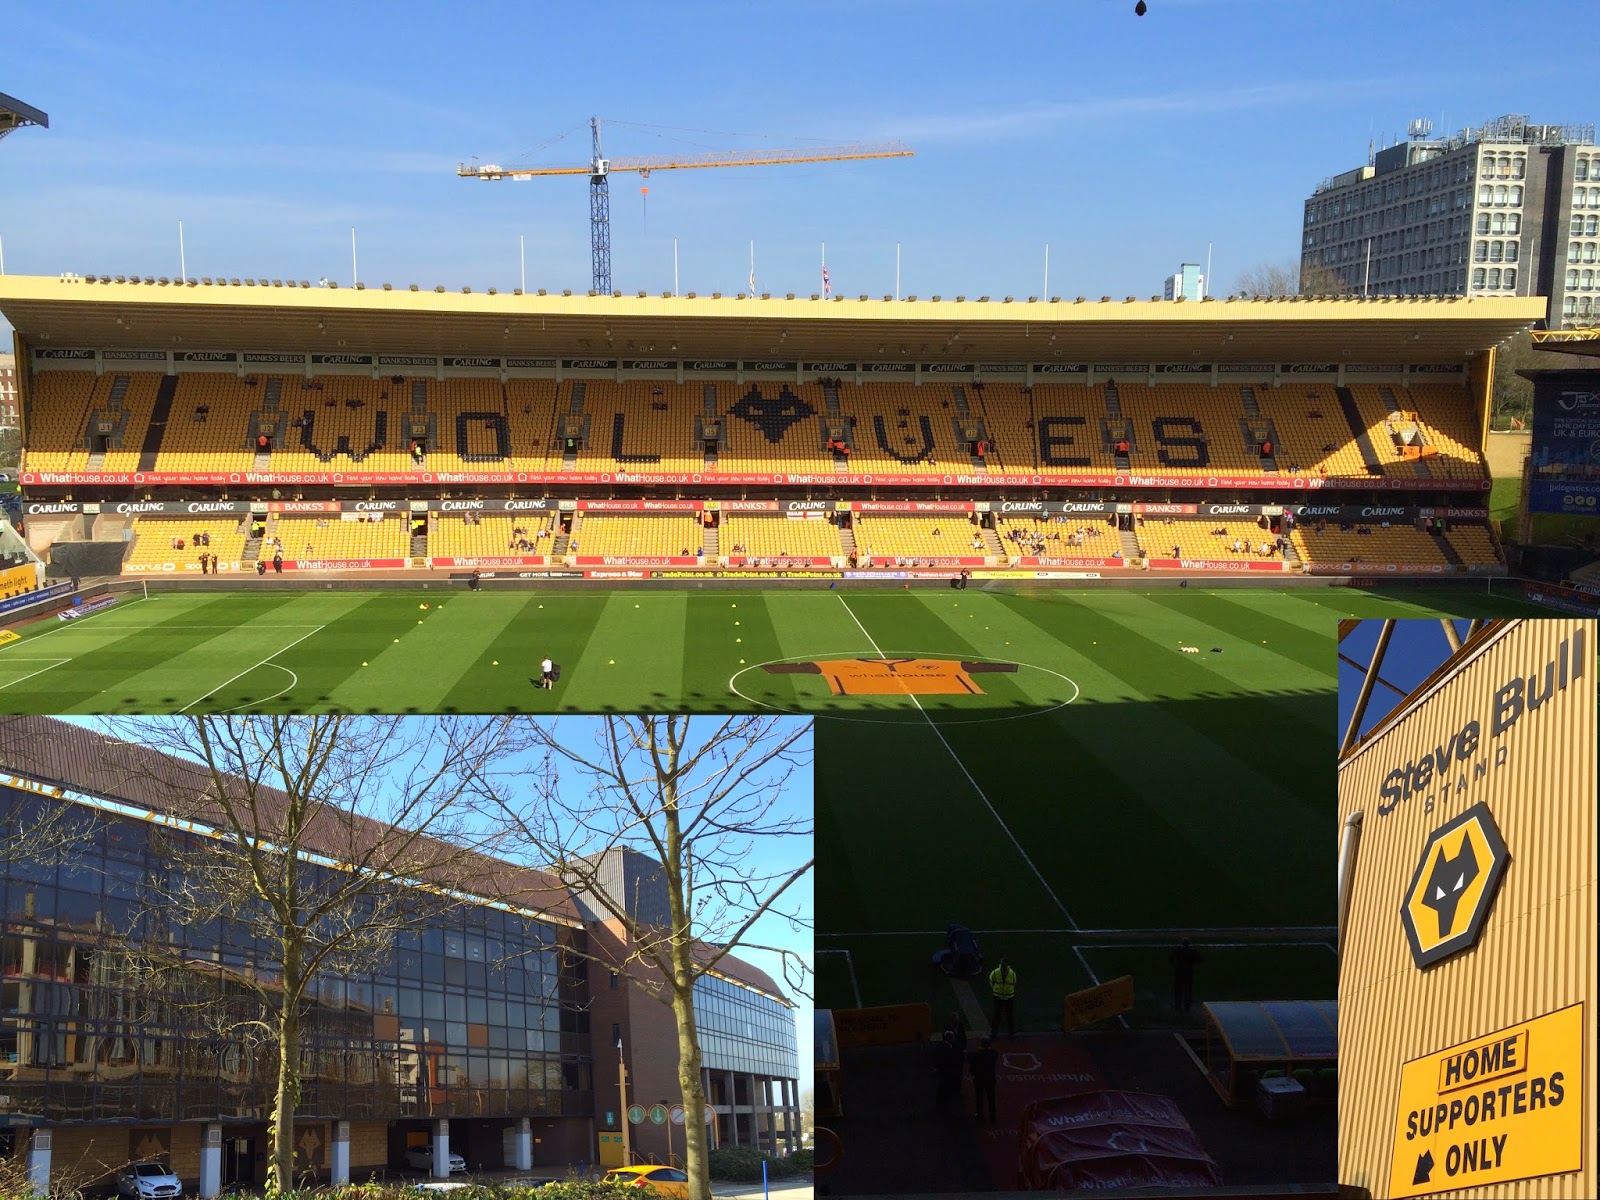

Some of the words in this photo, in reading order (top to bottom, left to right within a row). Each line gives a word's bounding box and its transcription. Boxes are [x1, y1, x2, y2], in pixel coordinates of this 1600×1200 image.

[183, 352, 228, 362] CARLING
[246, 354, 278, 362] BANKS'S
[279, 355, 304, 363] BEERS
[321, 354, 363, 364] CARLING
[413, 357, 435, 365] BEERS
[452, 358, 492, 368] CARLING
[570, 359, 609, 369] CARLING
[632, 360, 669, 370] CARLING
[693, 361, 727, 370] CARLING
[754, 362, 786, 371] CARLING
[811, 362, 848, 372] CARLING
[871, 363, 907, 373] CARLING
[929, 363, 966, 373] CARLING
[1289, 363, 1330, 373] CARLING
[1041, 364, 1080, 373] CARLING
[1163, 364, 1204, 374] CARLING
[1553, 429, 1567, 437] UK
[40, 473, 129, 483] WhatHouse.co.uk
[246, 473, 329, 482] WhatHouse.co.uk
[437, 473, 514, 482] WhatHouse.co.uk
[614, 473, 689, 482] WhatHouse.co.uk
[787, 474, 860, 483] WhatHouse.co.uk
[956, 475, 1029, 484] WhatHouse.co.uk
[1128, 476, 1204, 486] WhatHouse.co.uk
[1308, 478, 1388, 488] WhatHouse.co.uk
[28, 503, 77, 514] CARLING
[116, 502, 164, 513] CARLING
[187, 502, 234, 513] CARLING
[284, 502, 324, 511] BANKS'S
[355, 501, 396, 511] CARLING
[441, 500, 484, 511] CARLING
[504, 500, 546, 510] CARLING
[587, 501, 638, 509] WhatHouse.co.uk
[643, 501, 694, 509] WhatHouse.co.uk
[732, 501, 768, 510] BANKS'S
[788, 501, 826, 511] CARLING
[861, 502, 911, 510] WhatHouse.co.uk
[916, 502, 965, 510] WhatHouse.co.uk
[1001, 502, 1043, 512] CARLING
[1062, 502, 1105, 513] CARLING
[1145, 504, 1182, 513] BANKS'S
[1209, 505, 1250, 514] CARLING
[1297, 506, 1340, 516] CARLING
[1361, 507, 1405, 517] CARLING
[1447, 509, 1488, 518] BANKS'S
[296, 560, 371, 569] WhatHouse.co.uk
[453, 557, 523, 566] WhatHouse.co.uk
[603, 556, 671, 565] WhatHouse.co.uk
[1038, 557, 1105, 566] WhatHouse.co.uk
[1180, 560, 1250, 570] WhatHouse.co.uk
[1378, 720, 1480, 817] Steve
[1493, 627, 1583, 739] Bull
[1423, 745, 1508, 815] STAND
[1445, 1036, 1518, 1087] HOME
[1406, 1071, 1565, 1141] SUPPORTERS
[1445, 1134, 1508, 1177] ONLY
